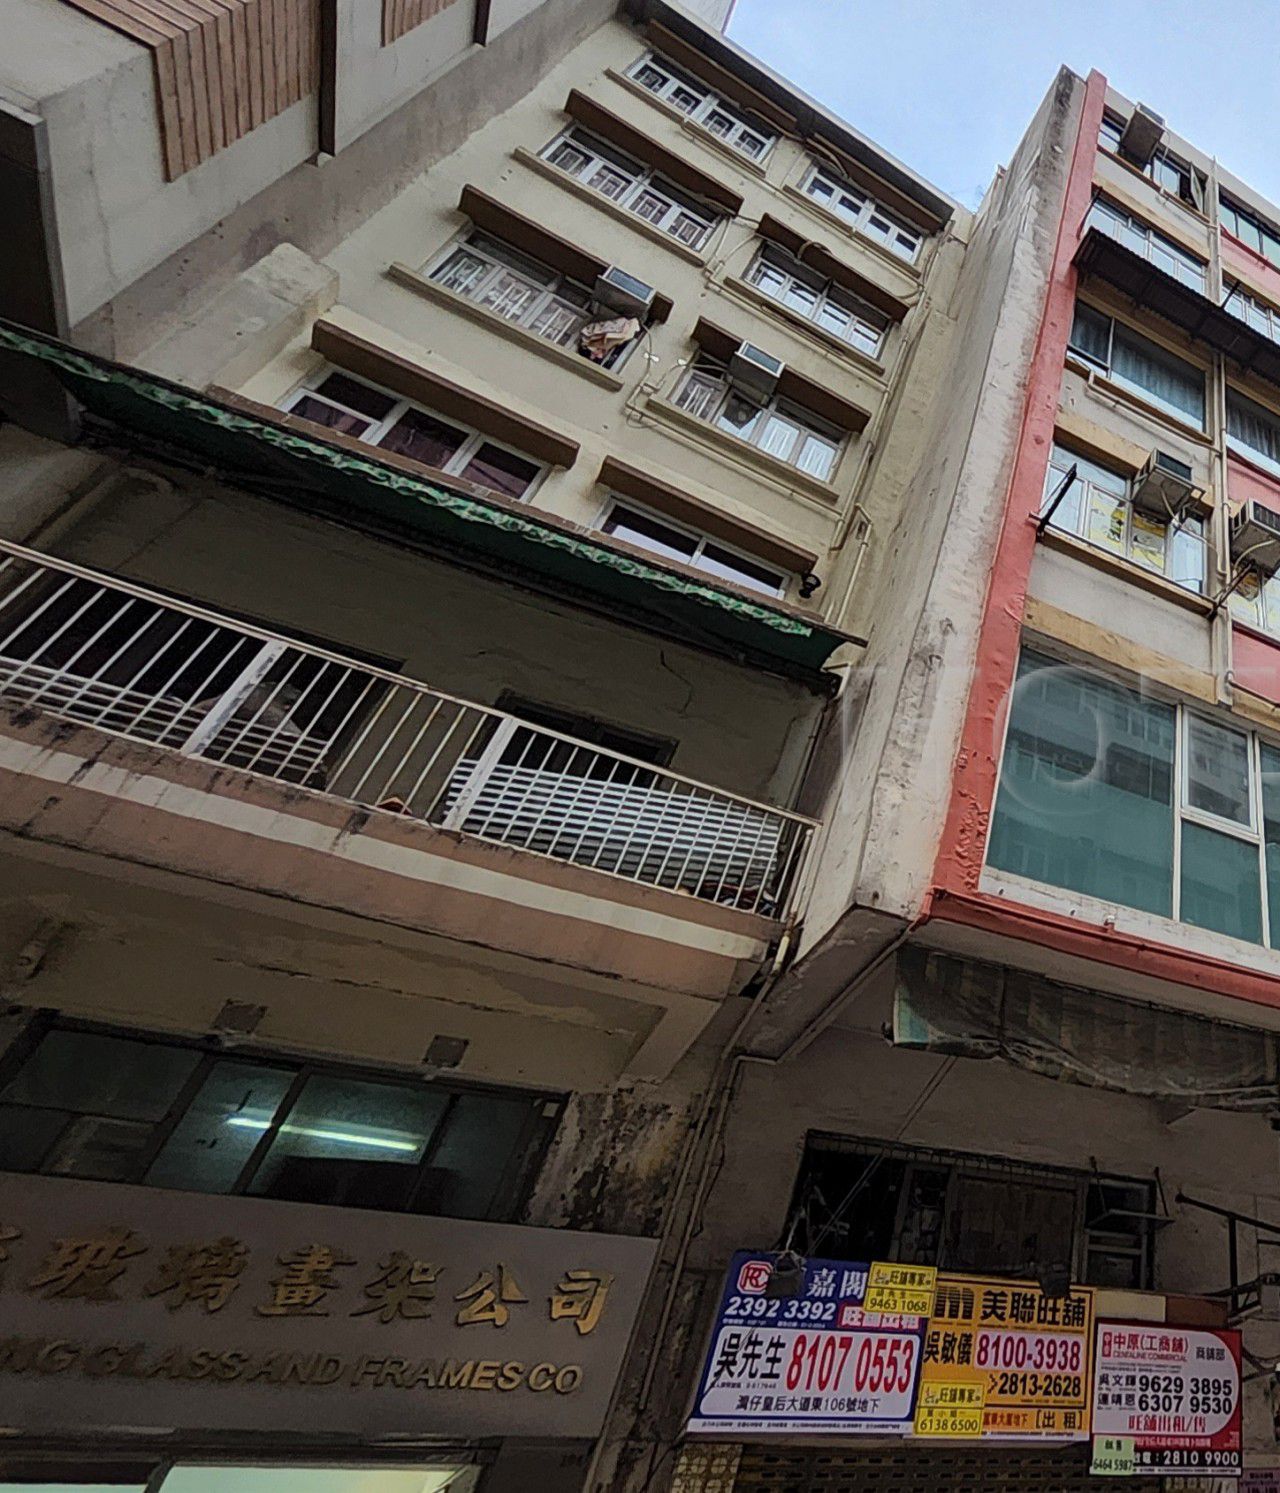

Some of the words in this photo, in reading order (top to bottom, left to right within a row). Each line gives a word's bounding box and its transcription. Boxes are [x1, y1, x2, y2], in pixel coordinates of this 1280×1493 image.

[0, 1221, 615, 1336] 玻璃畫架公司
[801, 1266, 868, 1301] 嘉閣
[724, 1296, 780, 1318] 2392
[783, 1300, 837, 1322] 3392
[870, 1297, 898, 1310] 9463
[902, 1300, 928, 1312] 1068
[786, 1334, 853, 1391] 8107
[856, 1337, 914, 1394] 0553
[976, 1334, 1081, 1371] 8100-3938
[351, 1355, 523, 1391] FRAMES
[527, 1362, 585, 1396] CO
[998, 1373, 1081, 1398] 2813-2628
[1138, 1375, 1184, 1393] 9629
[1189, 1377, 1233, 1396] 3895
[1138, 1394, 1184, 1413] 6307
[1189, 1396, 1233, 1415] 9530
[920, 1419, 949, 1431] 6138
[950, 1419, 978, 1432] 6500
[1163, 1450, 1199, 1466] 2810
[1204, 1451, 1239, 1467] 9900
